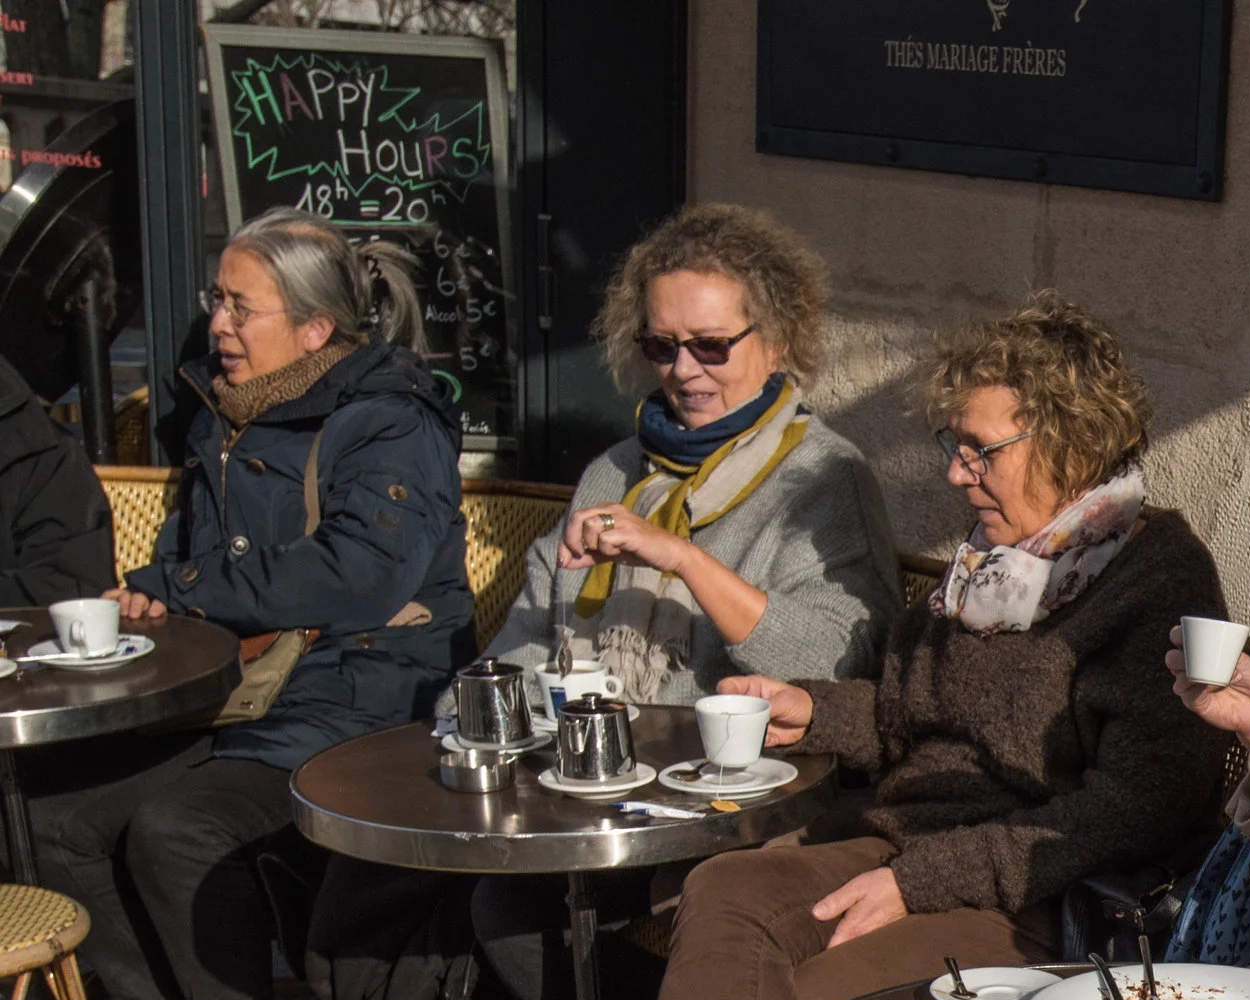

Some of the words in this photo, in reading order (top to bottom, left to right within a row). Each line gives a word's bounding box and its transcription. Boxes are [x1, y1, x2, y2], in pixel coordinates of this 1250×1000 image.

[884, 35, 924, 68] THÉS
[926, 42, 999, 73] MARIAGE
[1001, 40, 1066, 77] FRÈRES
